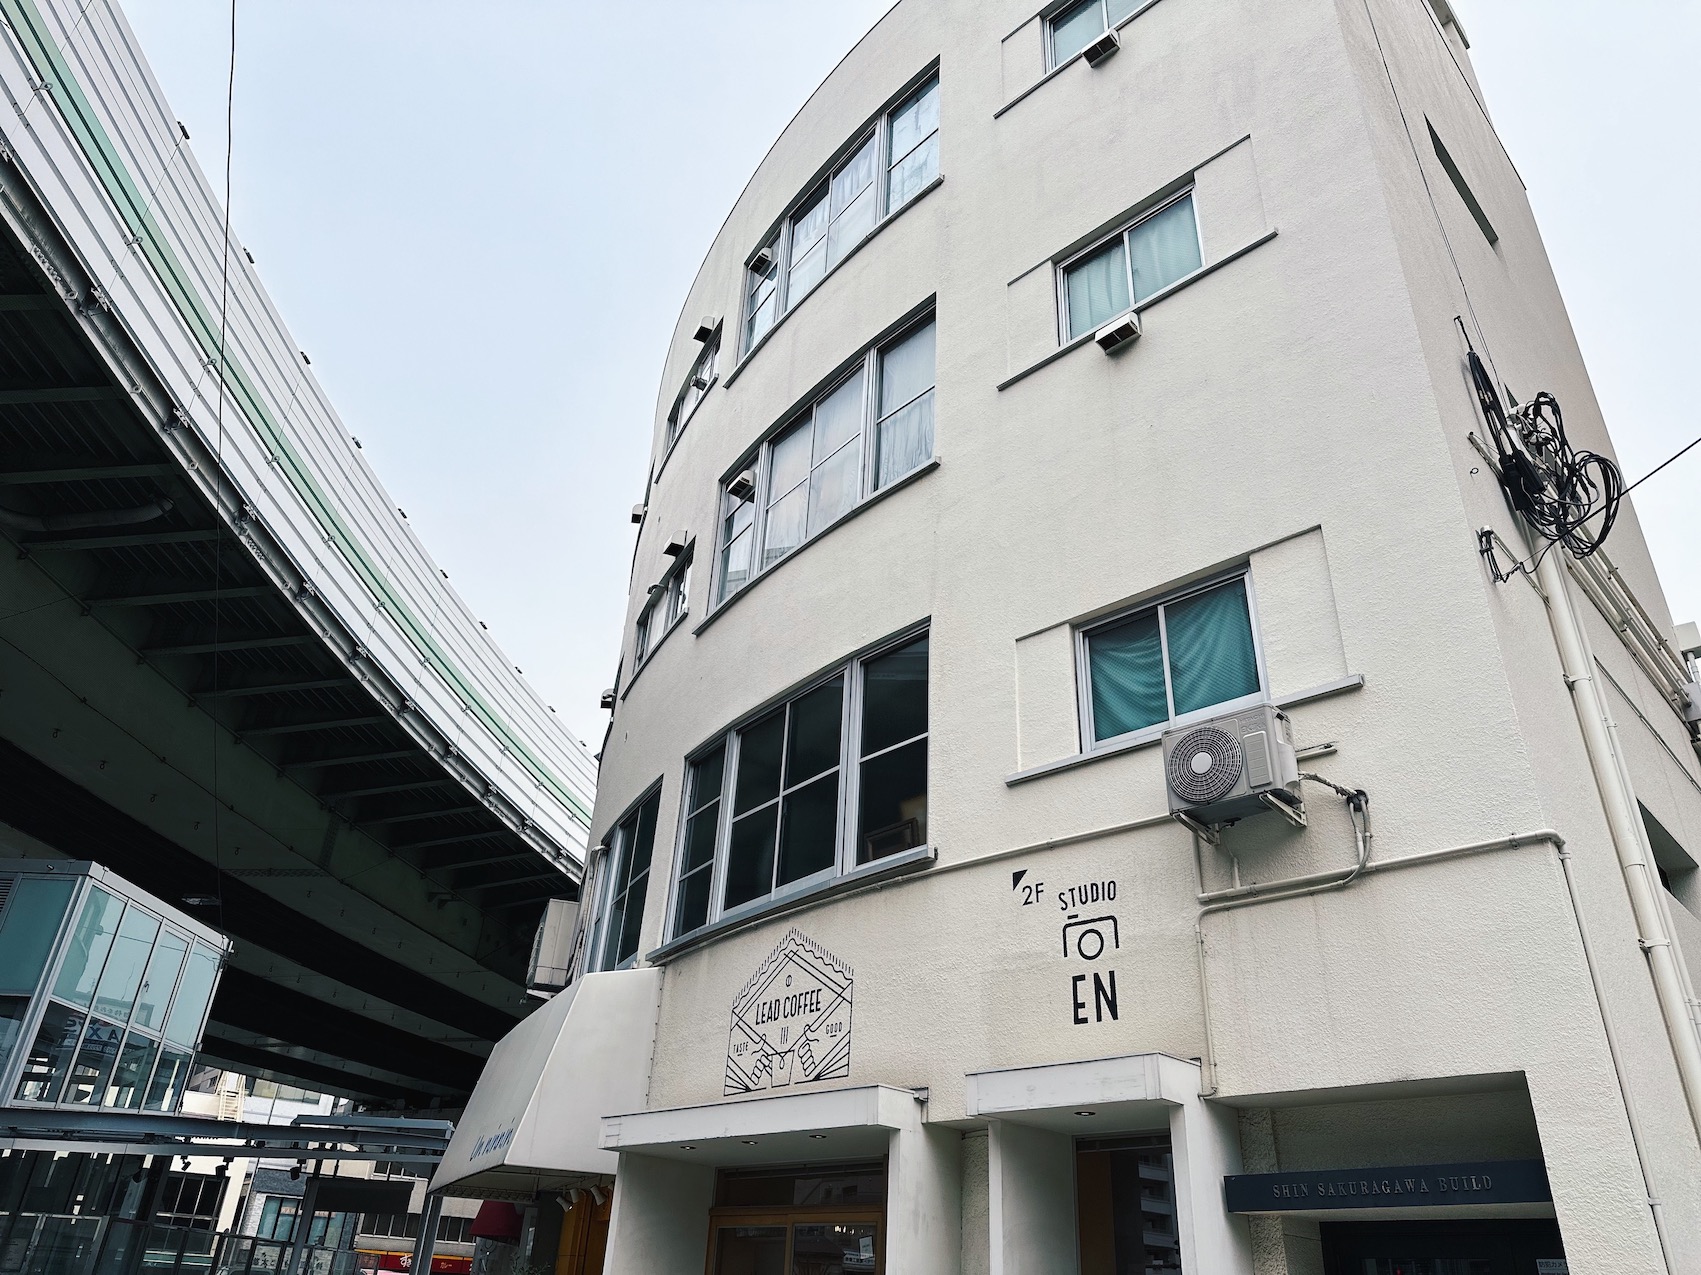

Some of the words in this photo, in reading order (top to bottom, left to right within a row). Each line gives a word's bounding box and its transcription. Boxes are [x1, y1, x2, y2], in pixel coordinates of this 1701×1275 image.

[1022, 882, 1044, 906] 2F
[1058, 880, 1117, 911] STUDIO
[755, 998, 781, 1026] LEAD
[783, 988, 823, 1019] COFFEE
[1072, 970, 1119, 1025] EN
[825, 1021, 843, 1035] GOOD
[733, 1041, 749, 1054] TASTE
[1272, 1183, 1310, 1198] SHIN
[1317, 1178, 1430, 1197] SAKURAGAWA
[1437, 1175, 1493, 1192] BUILD
